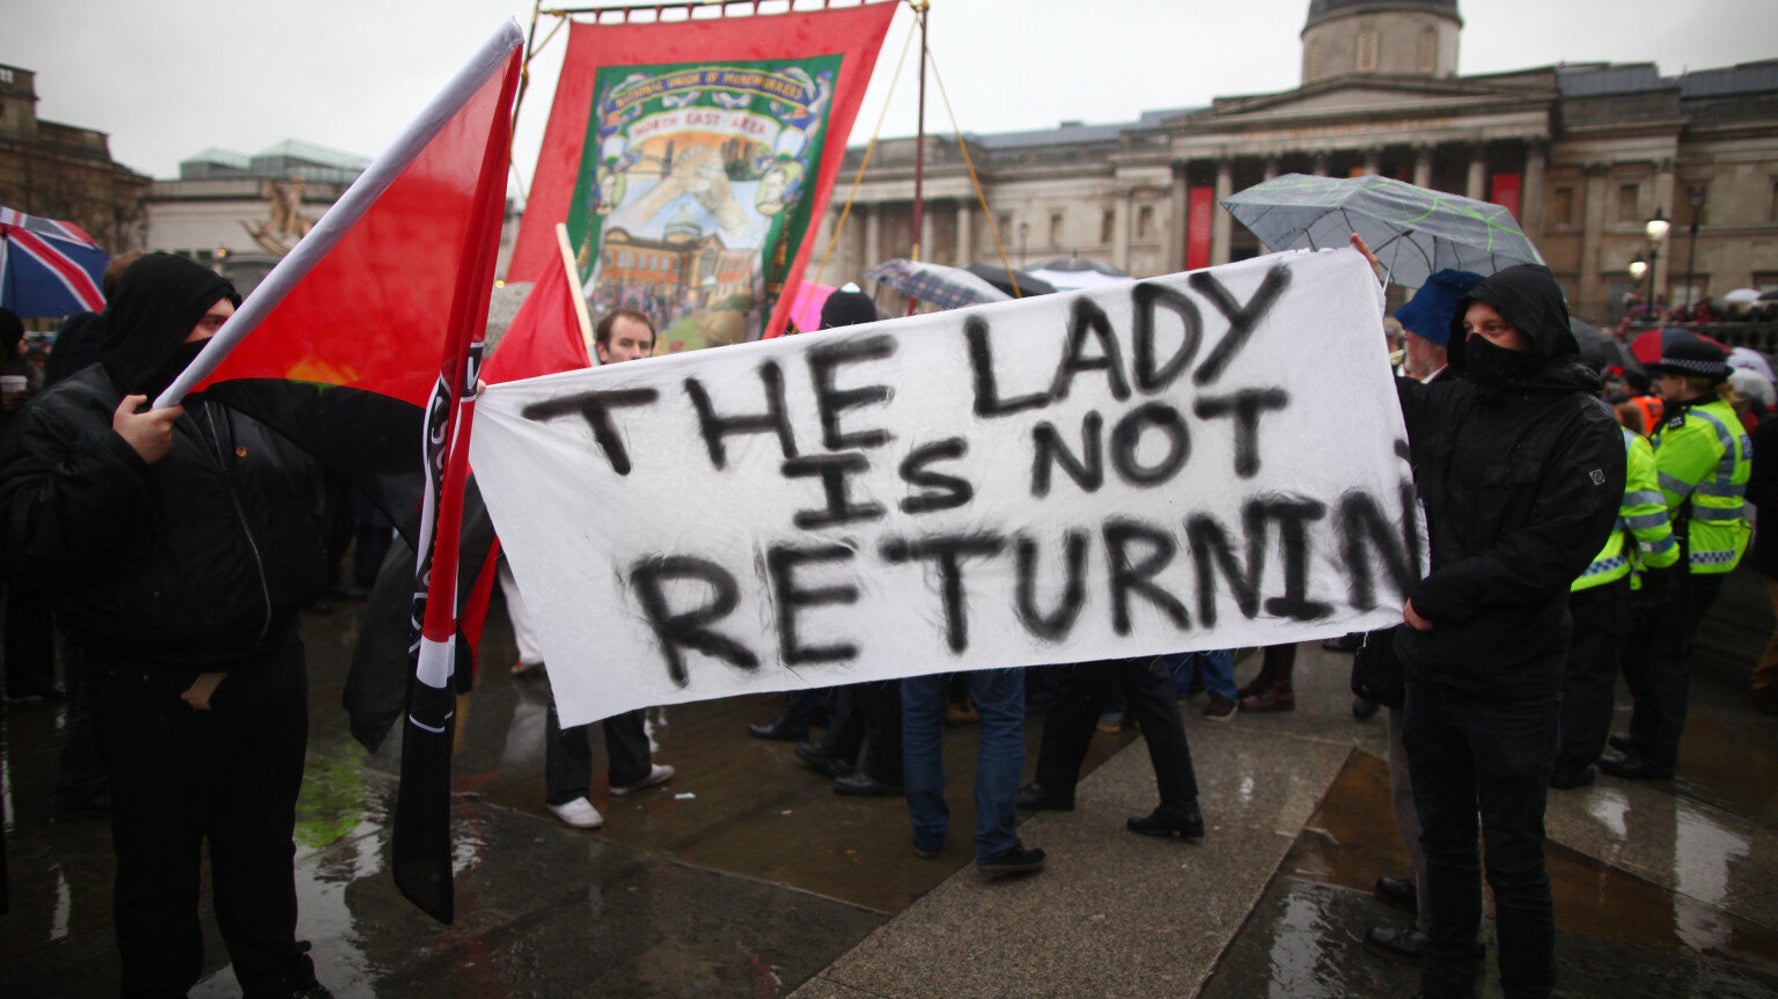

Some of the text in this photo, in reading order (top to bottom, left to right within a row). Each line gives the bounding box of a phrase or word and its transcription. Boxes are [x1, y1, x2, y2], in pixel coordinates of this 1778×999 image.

[705, 71, 719, 84] OF
[685, 112, 720, 124] EAST
[731, 116, 766, 133] AREA
[522, 265, 1294, 478] THE LADY
[781, 387, 1290, 530] IS NOT
